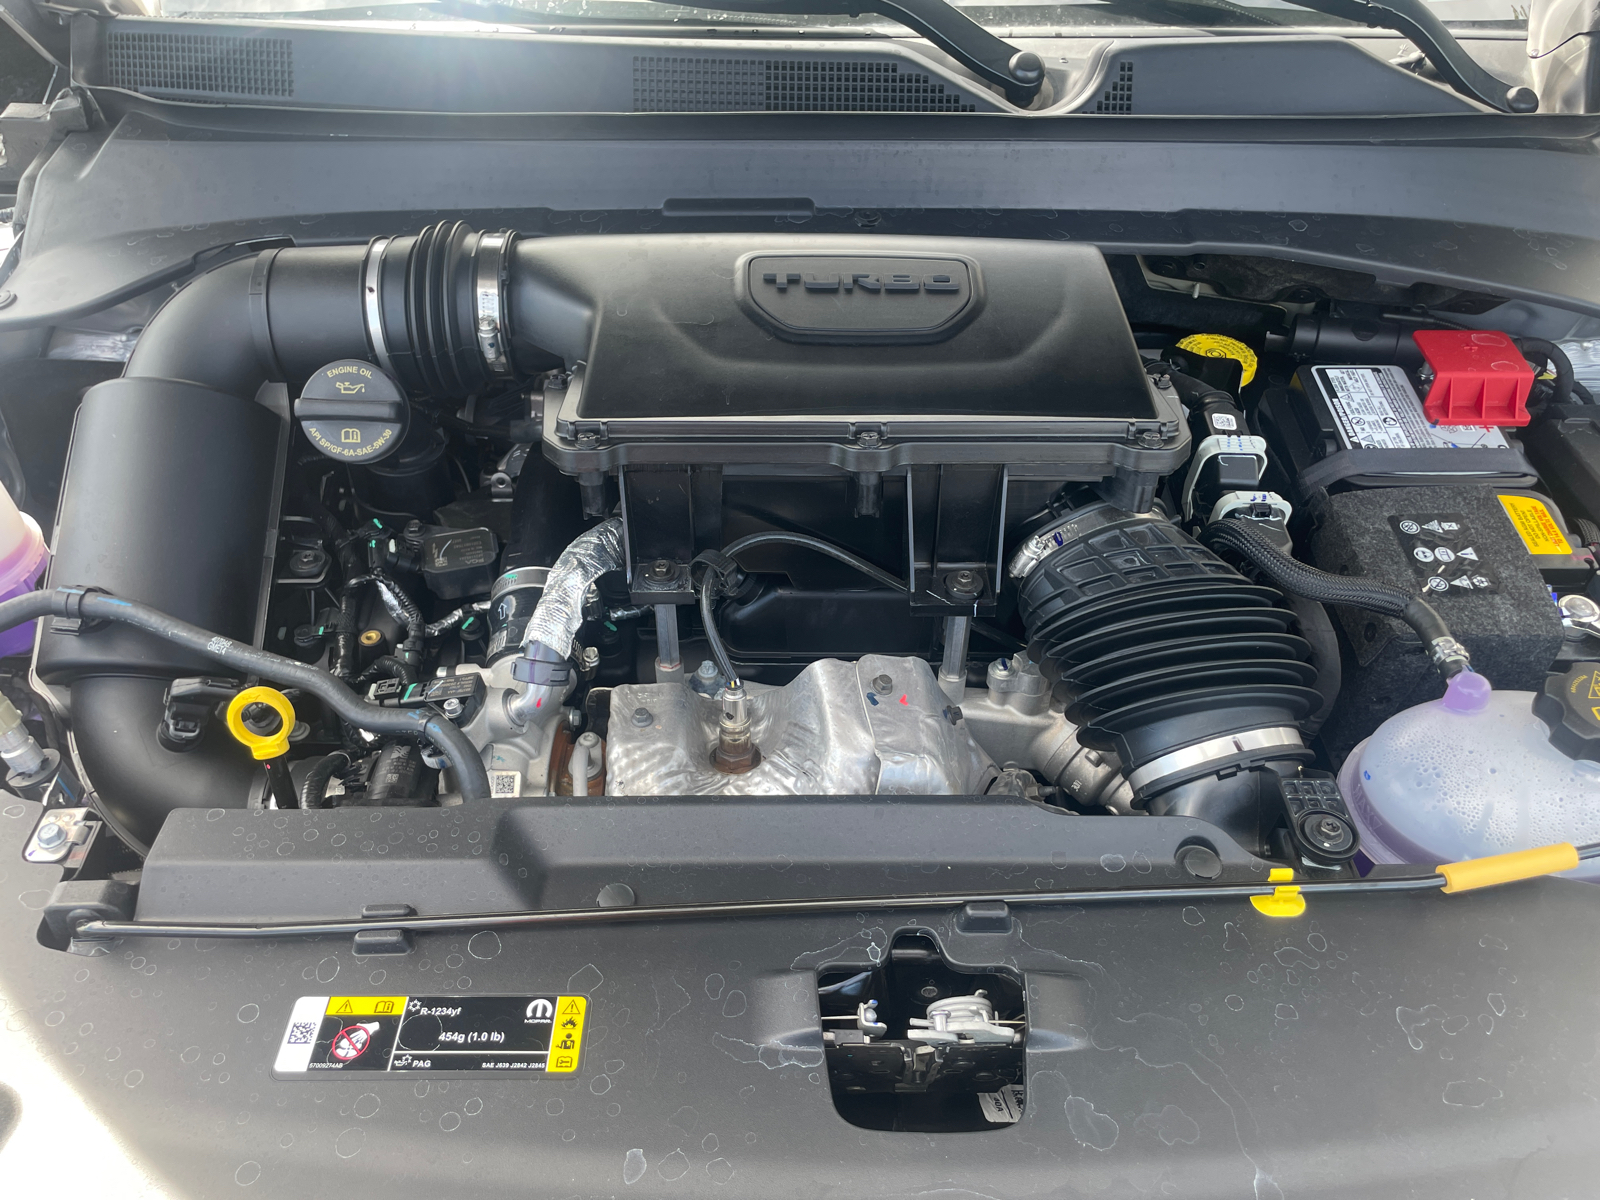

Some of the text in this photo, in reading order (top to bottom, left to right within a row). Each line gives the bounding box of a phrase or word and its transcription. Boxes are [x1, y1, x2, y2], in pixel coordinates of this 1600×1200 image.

[763, 272, 960, 291] TURBO
[327, 366, 372, 379] ENGINE OIL
[309, 427, 322, 440] API
[420, 1007, 461, 1017] R-1234yf
[439, 1032, 505, 1043] 454g (1.0 lb)
[412, 1060, 432, 1068] PAG
